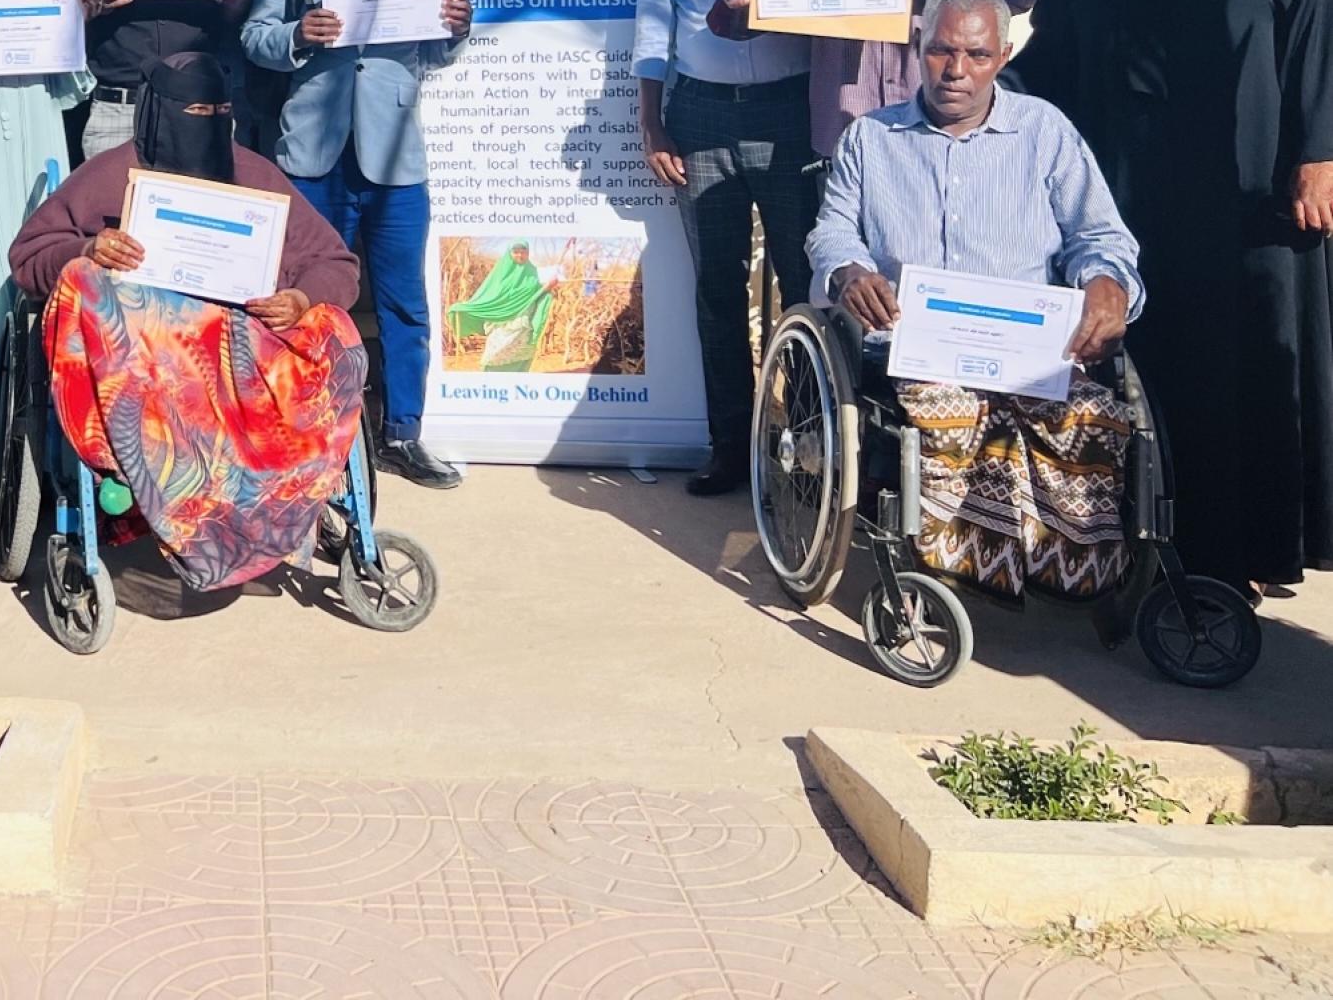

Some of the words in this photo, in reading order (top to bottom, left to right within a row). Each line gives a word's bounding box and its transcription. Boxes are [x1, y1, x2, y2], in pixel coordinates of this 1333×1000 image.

[468, 36, 499, 46] ome
[512, 52, 527, 64] of
[530, 52, 553, 63] the
[557, 51, 591, 62] IASC
[455, 70, 469, 81] of
[481, 69, 535, 81] Persons
[546, 69, 578, 80] with
[483, 87, 529, 99] Action
[540, 86, 556, 100] by
[440, 105, 530, 117] humanitarian
[556, 103, 603, 117] actors,
[480, 122, 494, 134] of
[501, 124, 555, 136] persons
[561, 122, 592, 134] with
[598, 121, 641, 133] disabi
[425, 141, 453, 152] rted
[472, 140, 526, 154] through
[545, 140, 603, 154] capacity
[427, 159, 477, 171] pment,
[486, 158, 518, 169] local
[530, 158, 592, 170] technical
[486, 175, 571, 188] mechanisms
[577, 175, 602, 188] and
[606, 178, 623, 188] an
[451, 195, 483, 206] base
[488, 194, 543, 208] through
[548, 194, 599, 208] applied
[605, 193, 664, 206] research
[430, 212, 485, 224] ractices
[441, 383, 508, 401] Leaving
[515, 385, 539, 400] No
[545, 385, 583, 401] One
[587, 387, 649, 402] Behind
